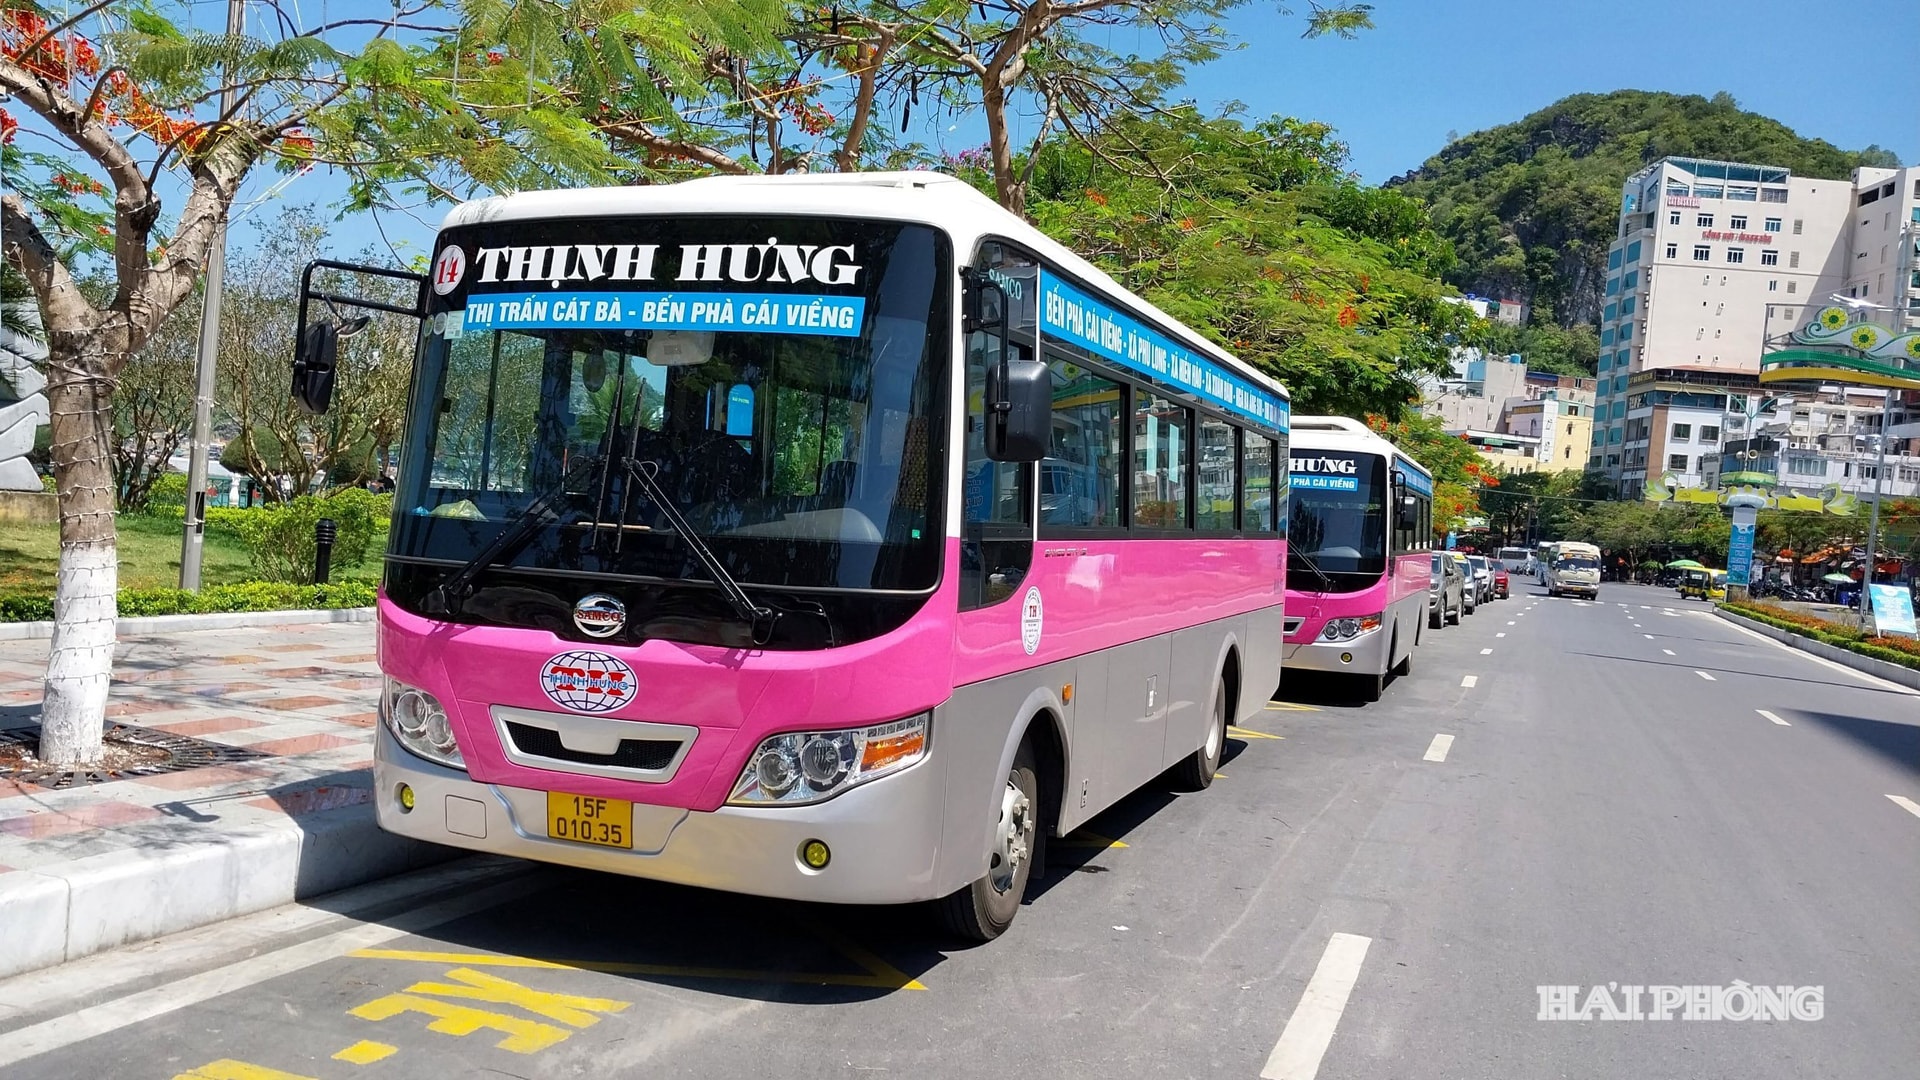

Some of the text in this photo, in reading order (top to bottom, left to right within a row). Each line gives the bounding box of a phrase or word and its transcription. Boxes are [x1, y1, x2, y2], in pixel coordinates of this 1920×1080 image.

[436, 256, 459, 285] 14
[475, 236, 863, 289] THỊNH HƯNG
[467, 302, 495, 327] THỊ
[500, 294, 548, 322] TRẤN
[552, 296, 591, 322] CÁT
[594, 296, 622, 322] BÀ
[642, 294, 687, 323] BẾN
[690, 298, 734, 324] PHÀ
[741, 299, 780, 326] CÁI
[786, 297, 855, 329] VIỀNG
[1046, 284, 1065, 329] BẾN
[1066, 300, 1084, 338] PHÀ
[1085, 307, 1099, 344] CÁI
[1289, 456, 1358, 474] HƯNG
[576, 609, 621, 623] SAMCO
[573, 796, 607, 819] 15F
[556, 817, 622, 844] 010.35
